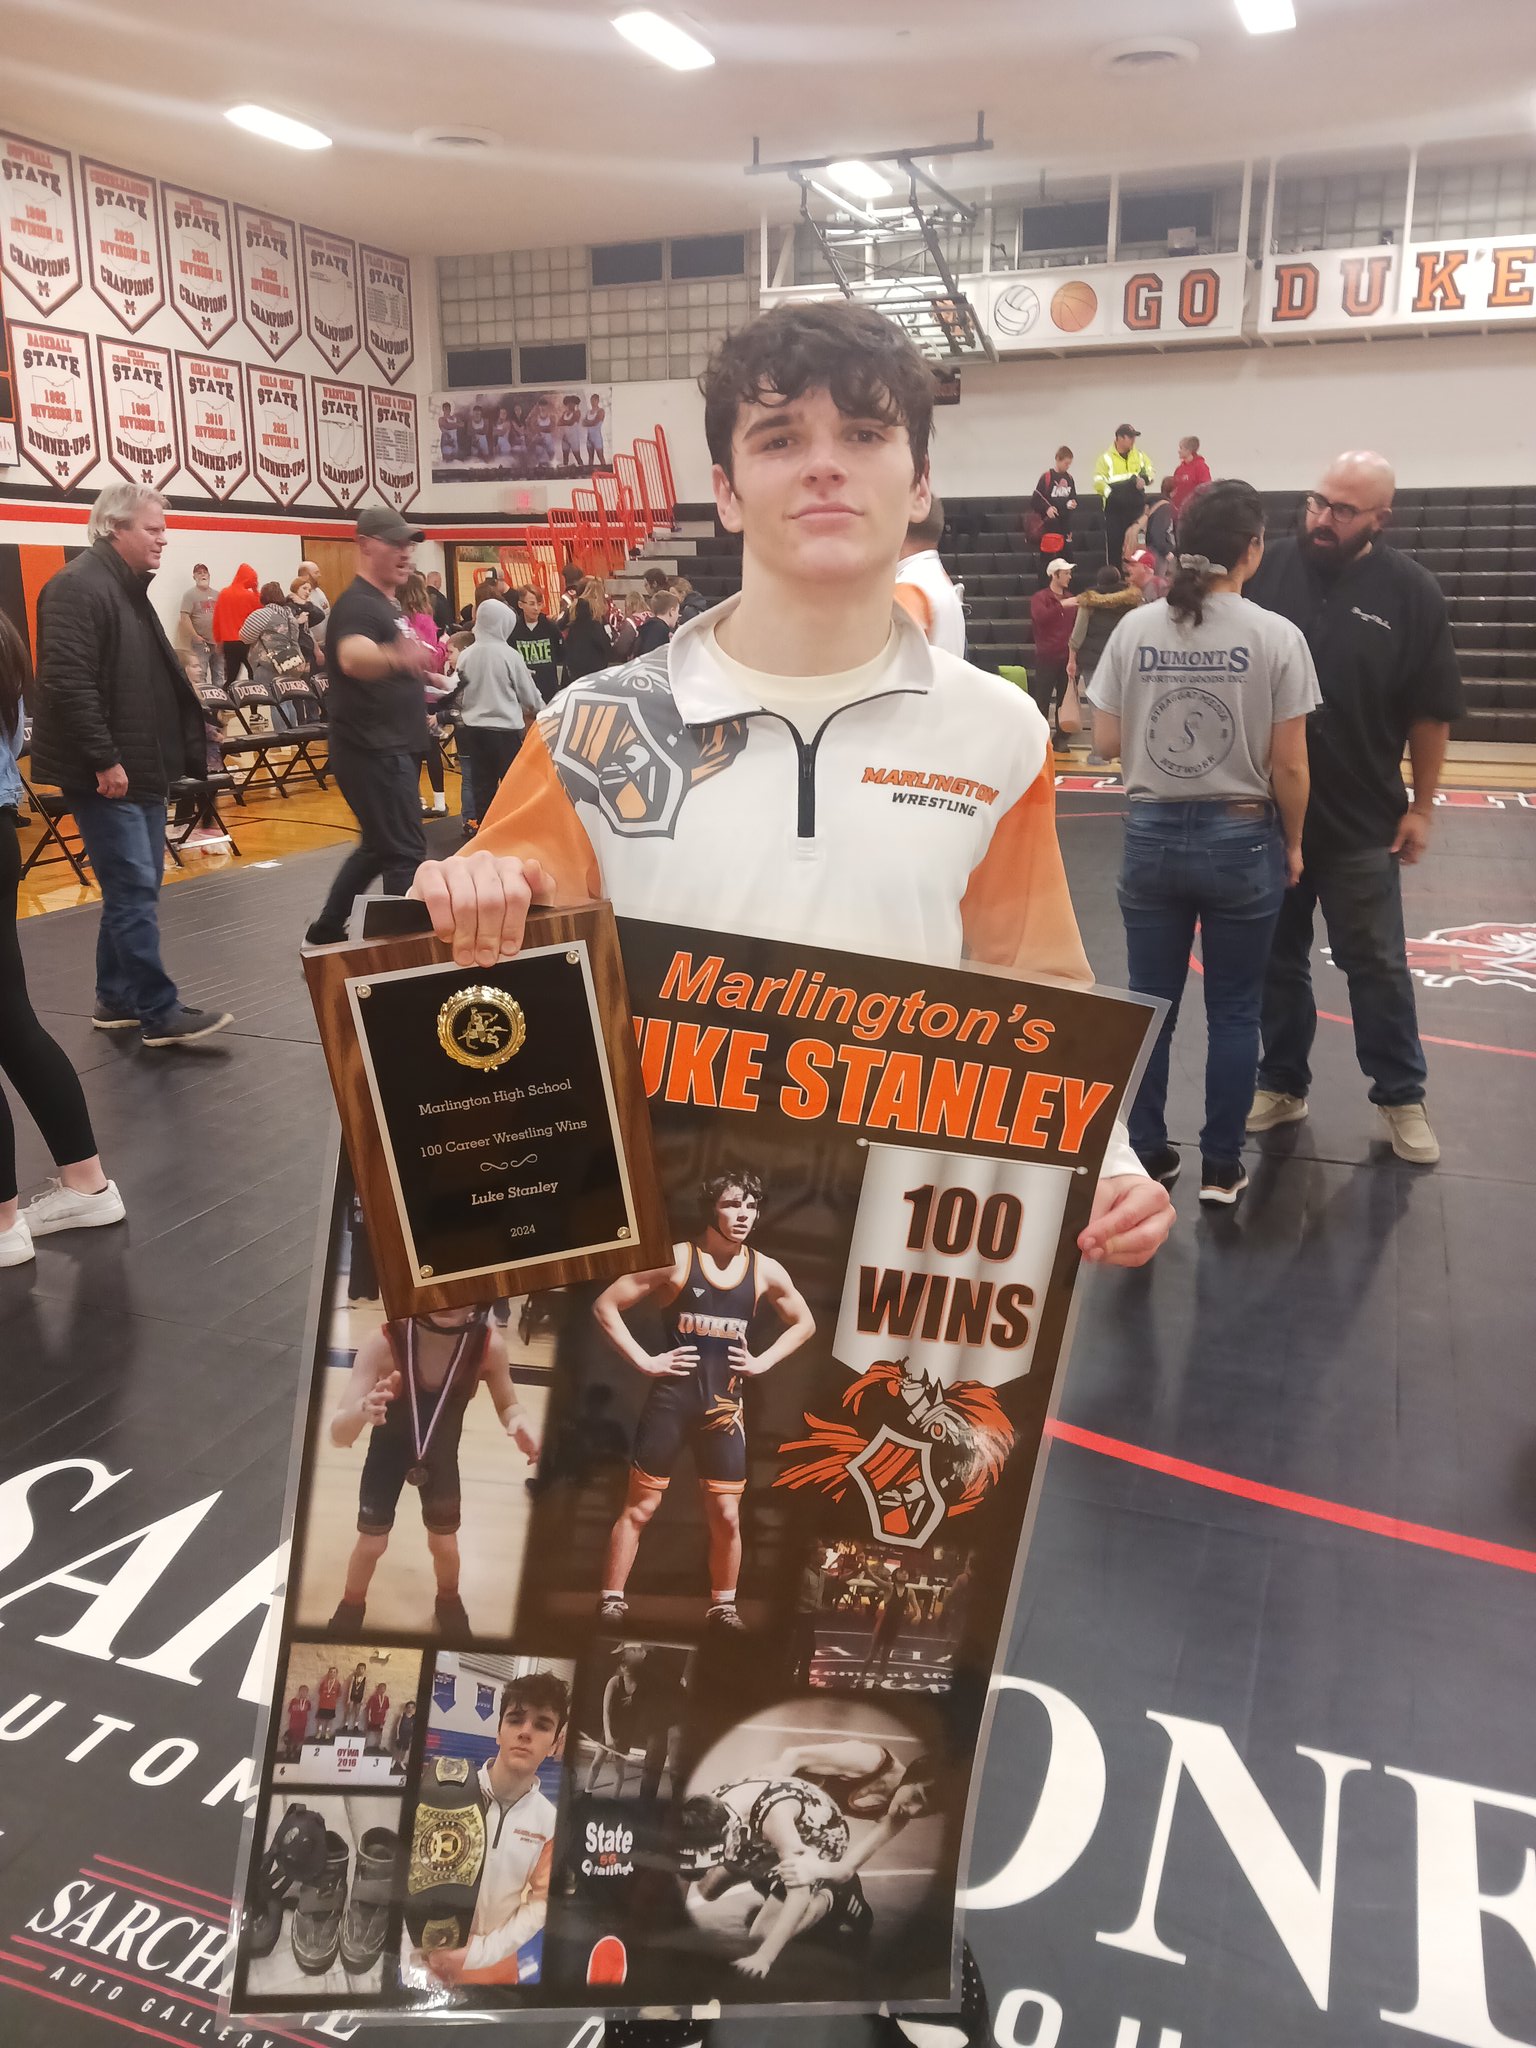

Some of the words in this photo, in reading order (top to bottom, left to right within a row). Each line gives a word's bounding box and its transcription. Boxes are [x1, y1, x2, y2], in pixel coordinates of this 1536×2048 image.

[2, 159, 61, 197] STATE
[95, 187, 147, 220] STATE
[174, 210, 221, 240] STATE
[246, 230, 288, 260] STATE
[10, 243, 70, 277] CHAMPIONS
[310, 249, 349, 277] STATE
[100, 264, 154, 296] CHAMPIONS
[369, 268, 404, 294] STATE
[1123, 268, 1220, 330] GO
[1272, 246, 1536, 322] DUKE
[179, 283, 227, 313] CHAMPIONS
[251, 299, 293, 328] CHAMPIONS
[314, 315, 353, 342] CHAMPIONS
[370, 329, 408, 355] CHAMPIONS
[27, 333, 72, 353] BASEBALL
[23, 349, 80, 379] STATE
[112, 363, 164, 391] STATE
[190, 362, 211, 377] GIRLS
[213, 366, 229, 380] GOLF
[188, 376, 235, 402] STATE
[259, 374, 277, 387] GIRLS
[30, 403, 71, 422] DIVISION
[257, 388, 298, 412] STATE
[321, 400, 358, 422] STATE
[377, 407, 411, 429] STATE
[27, 425, 91, 457] RUNNER-UPS
[116, 436, 172, 465] RUNNER-UPS
[191, 445, 242, 471] RUNNER-UPS
[259, 453, 305, 478] RUNNER-UPS
[322, 461, 364, 484] CHAMPIONS
[379, 467, 414, 488] CHAMPIONS
[235, 684, 269, 700] DUKES
[277, 680, 309, 694] DUKES
[1189, 675, 1225, 683] GOODS
[861, 767, 999, 805] MARLINGTON
[892, 792, 977, 817] WRESTLING
[658, 950, 1056, 1053] Marlington's
[418, 1094, 491, 1116] Marlington
[493, 1088, 525, 1103] High
[528, 1078, 572, 1097] School
[780, 1037, 1115, 1154] STANLEY
[420, 1143, 443, 1158] 100
[445, 1136, 491, 1153] Career
[492, 1126, 553, 1145] Wrestling
[555, 1119, 587, 1133] Wins
[471, 1191, 504, 1206] Luke
[507, 1182, 558, 1199] Stanley
[510, 1224, 536, 1237] 2024
[902, 1184, 1025, 1263] 100
[856, 1264, 1037, 1351] WINS
[337, 1758, 357, 1767] 2016
[585, 1821, 633, 1854] State
[49, 1966, 123, 2000] AUTO
